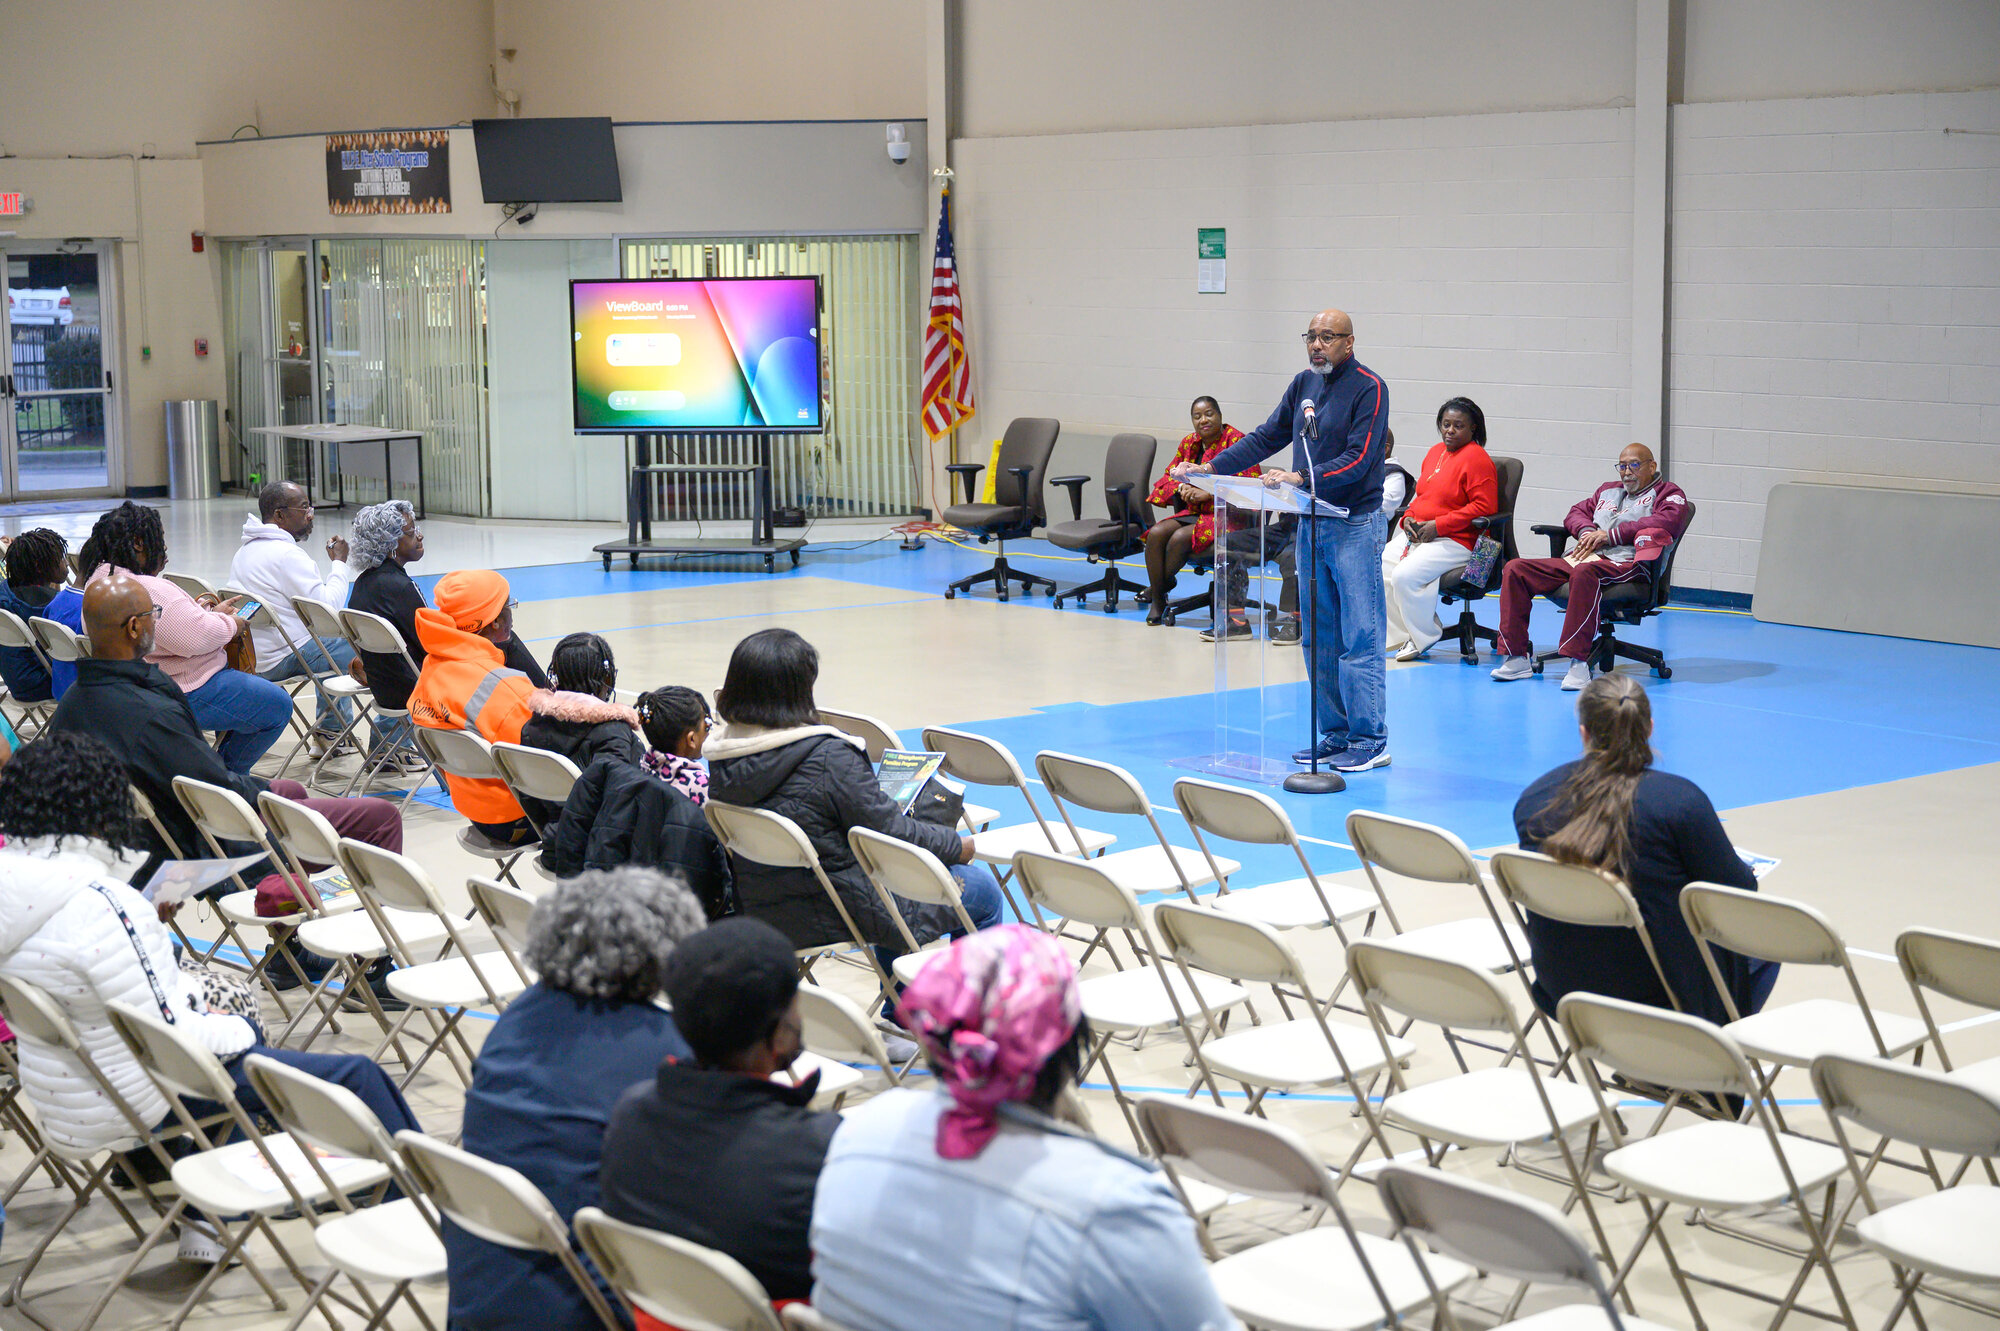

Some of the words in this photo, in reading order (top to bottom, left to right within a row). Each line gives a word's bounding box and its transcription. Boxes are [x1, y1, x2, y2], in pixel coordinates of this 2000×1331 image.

[374, 149, 394, 168] School
[394, 148, 429, 171] Programs
[361, 169, 383, 182] NOTHING
[383, 168, 402, 182] GIVEN
[354, 182, 384, 196] EVERYTHING
[606, 300, 663, 312] ViewBoard
